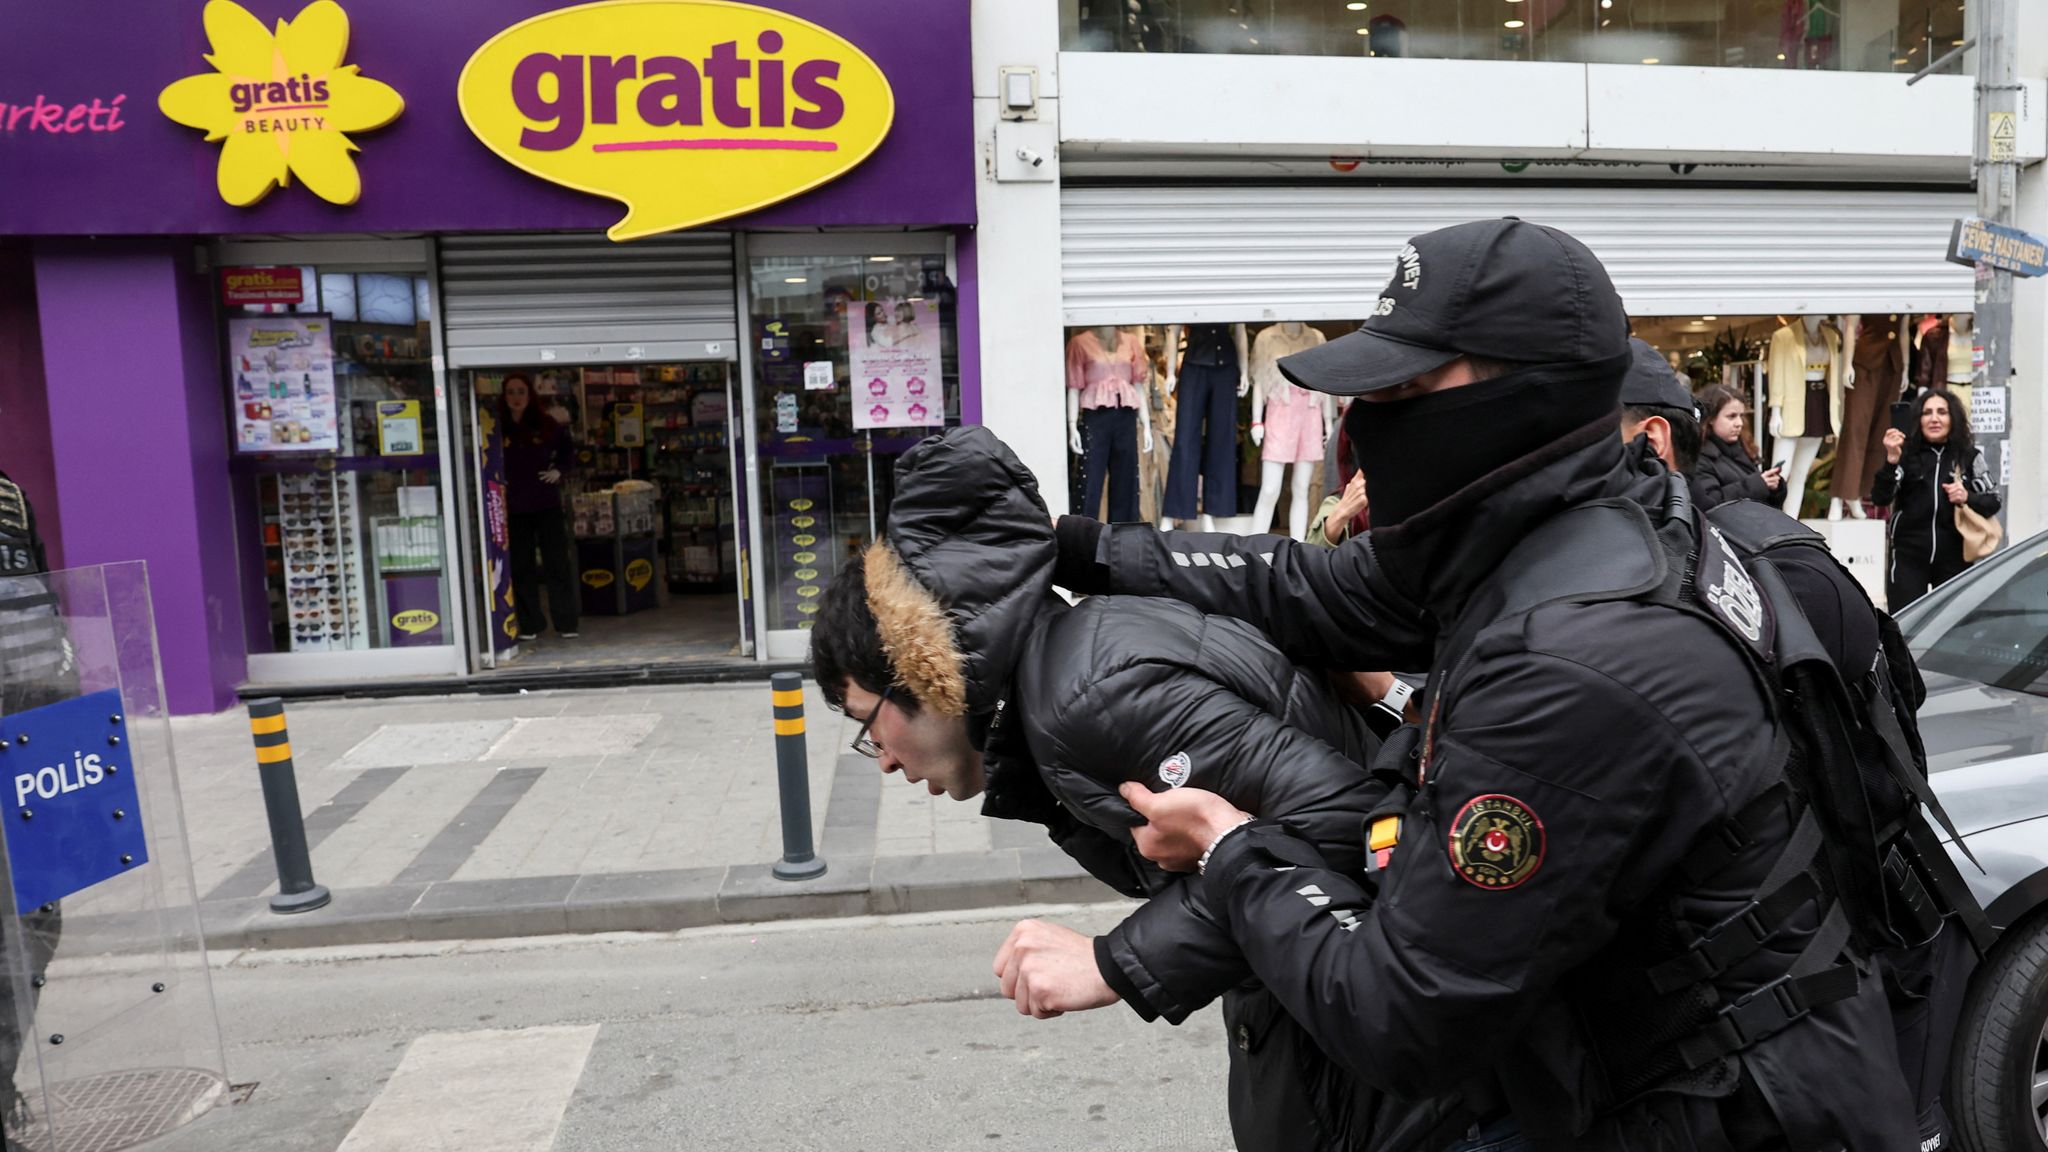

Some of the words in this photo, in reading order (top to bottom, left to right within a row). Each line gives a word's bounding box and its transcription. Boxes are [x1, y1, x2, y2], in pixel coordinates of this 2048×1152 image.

[230, 73, 330, 113] gratis
[511, 29, 845, 152] gratis
[245, 117, 324, 133] BEAUTY
[397, 612, 433, 627] gratis
[15, 750, 104, 807] POLİS
